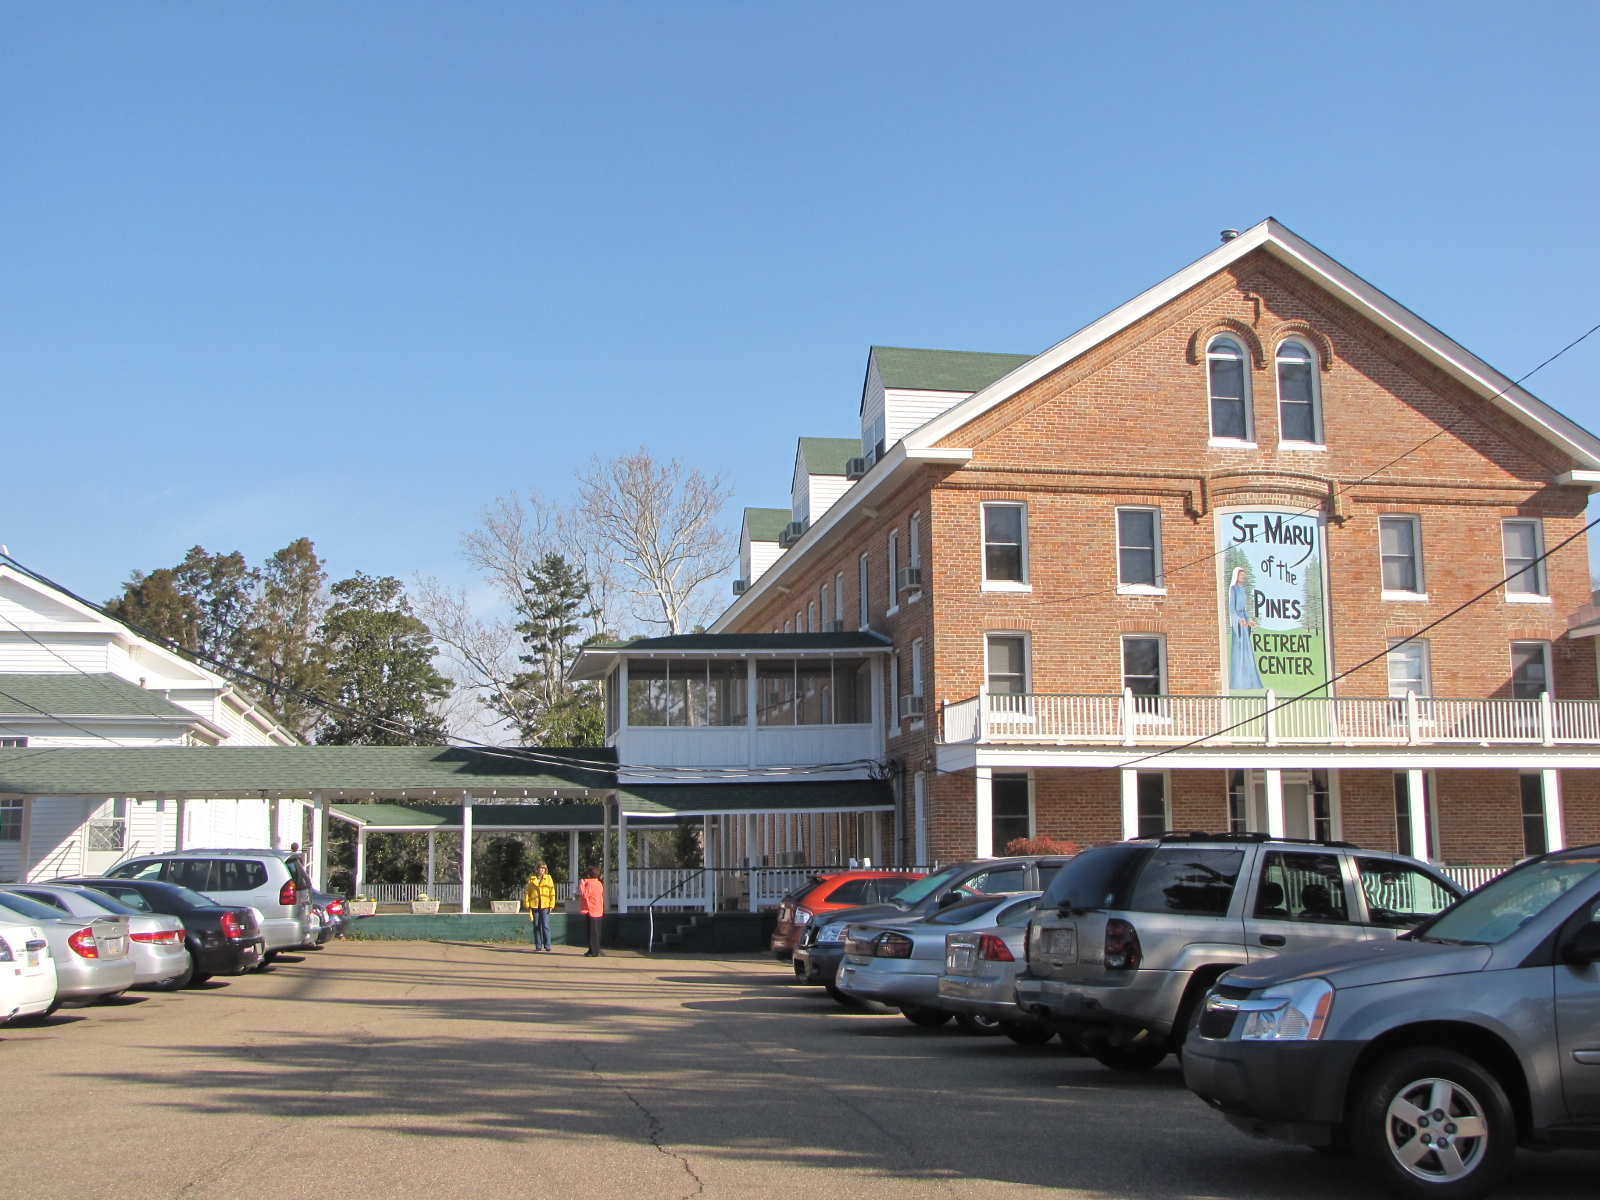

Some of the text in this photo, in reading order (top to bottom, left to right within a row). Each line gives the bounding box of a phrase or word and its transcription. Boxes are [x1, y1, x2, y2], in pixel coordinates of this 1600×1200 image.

[1264, 515, 1314, 568] MARY
[1261, 555, 1298, 586] of the
[1254, 589, 1301, 620] PINES
[1253, 634, 1312, 653] RETREAT
[1258, 655, 1315, 676] CENTER
